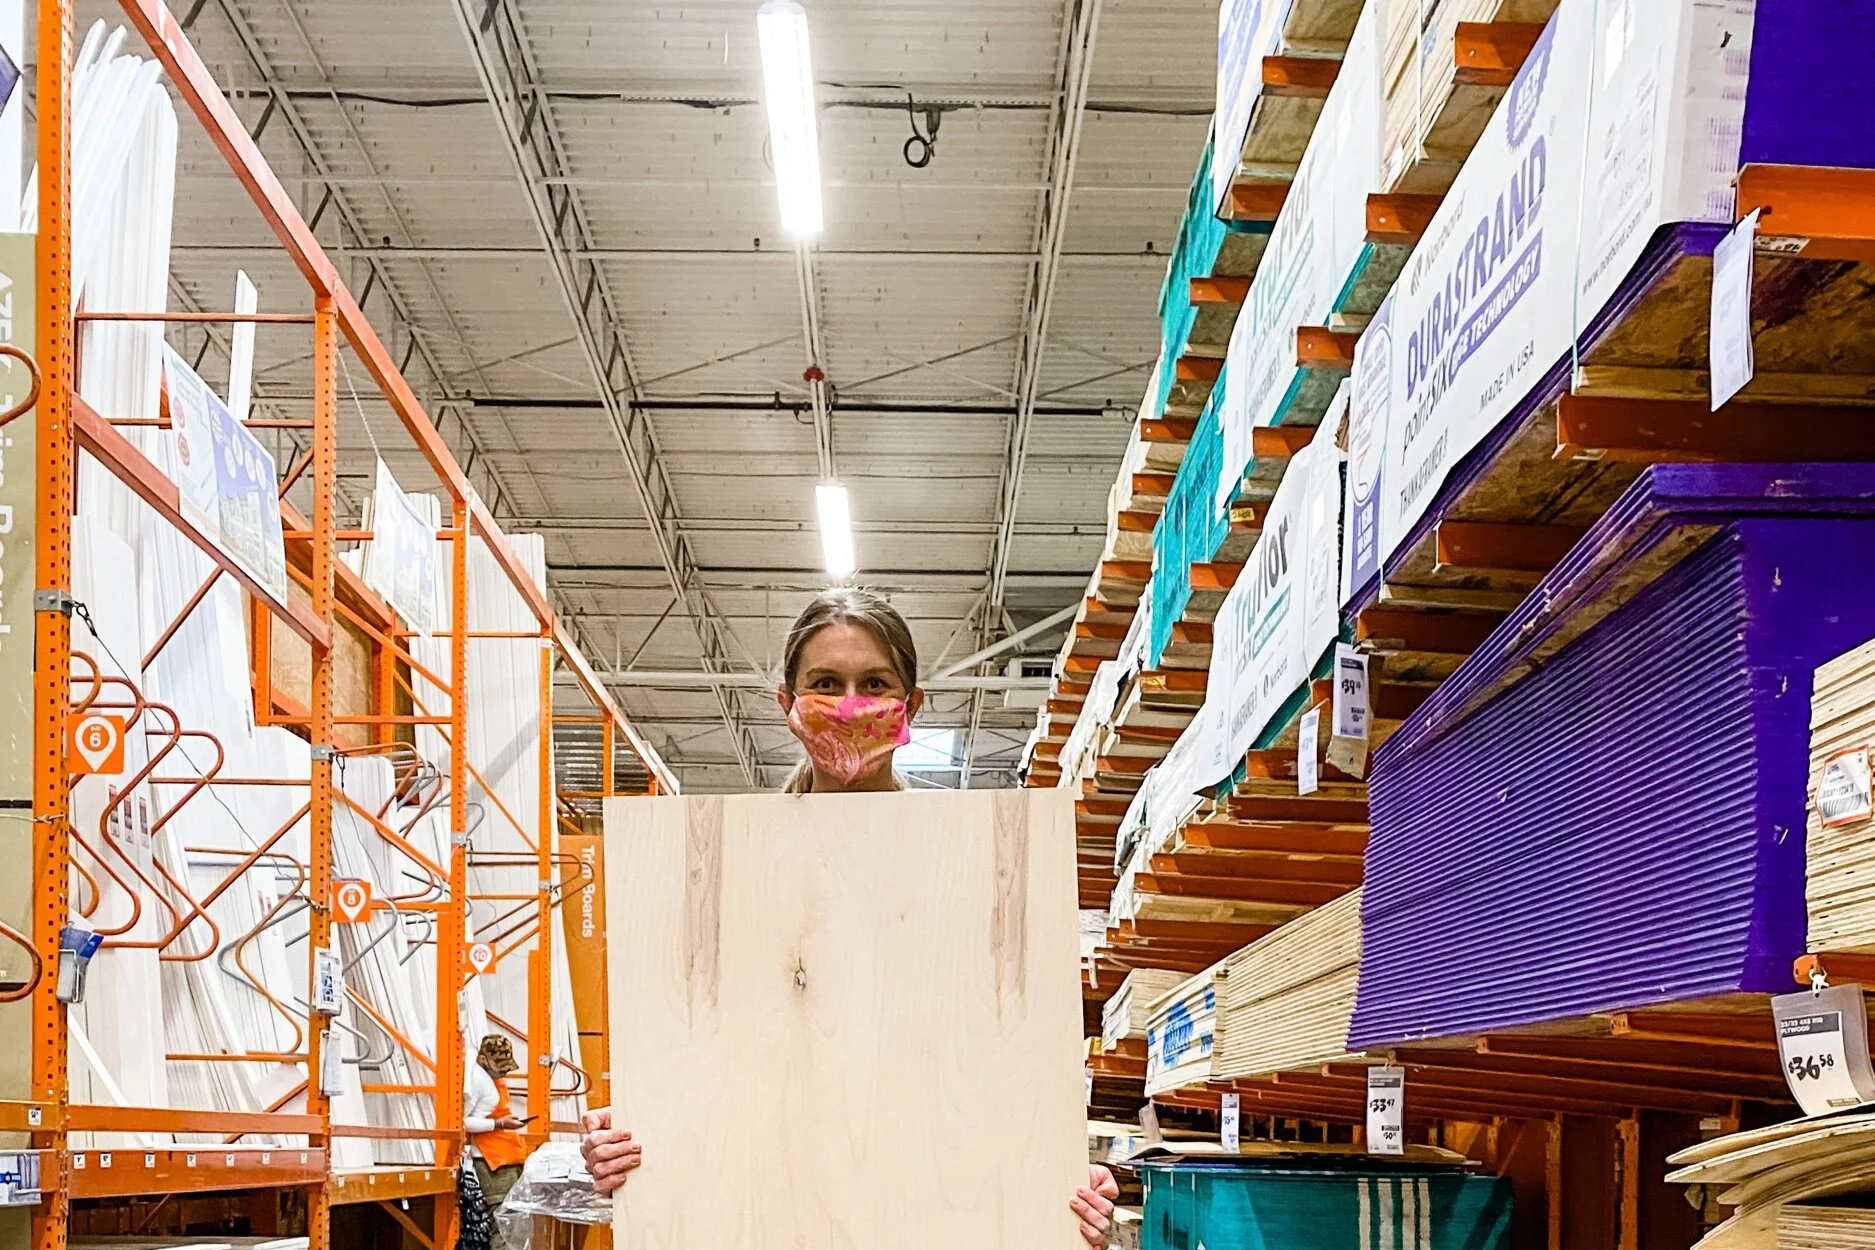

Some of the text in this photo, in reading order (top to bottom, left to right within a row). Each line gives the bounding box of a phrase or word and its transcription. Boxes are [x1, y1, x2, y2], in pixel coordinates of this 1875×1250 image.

[1407, 135, 1546, 402] DURASTRAND
[1471, 243, 1541, 346] TECHNOLOGY
[1479, 339, 1535, 412] MADE IN USA
[89, 732, 102, 748] 6
[581, 845, 596, 937] Trim Boards
